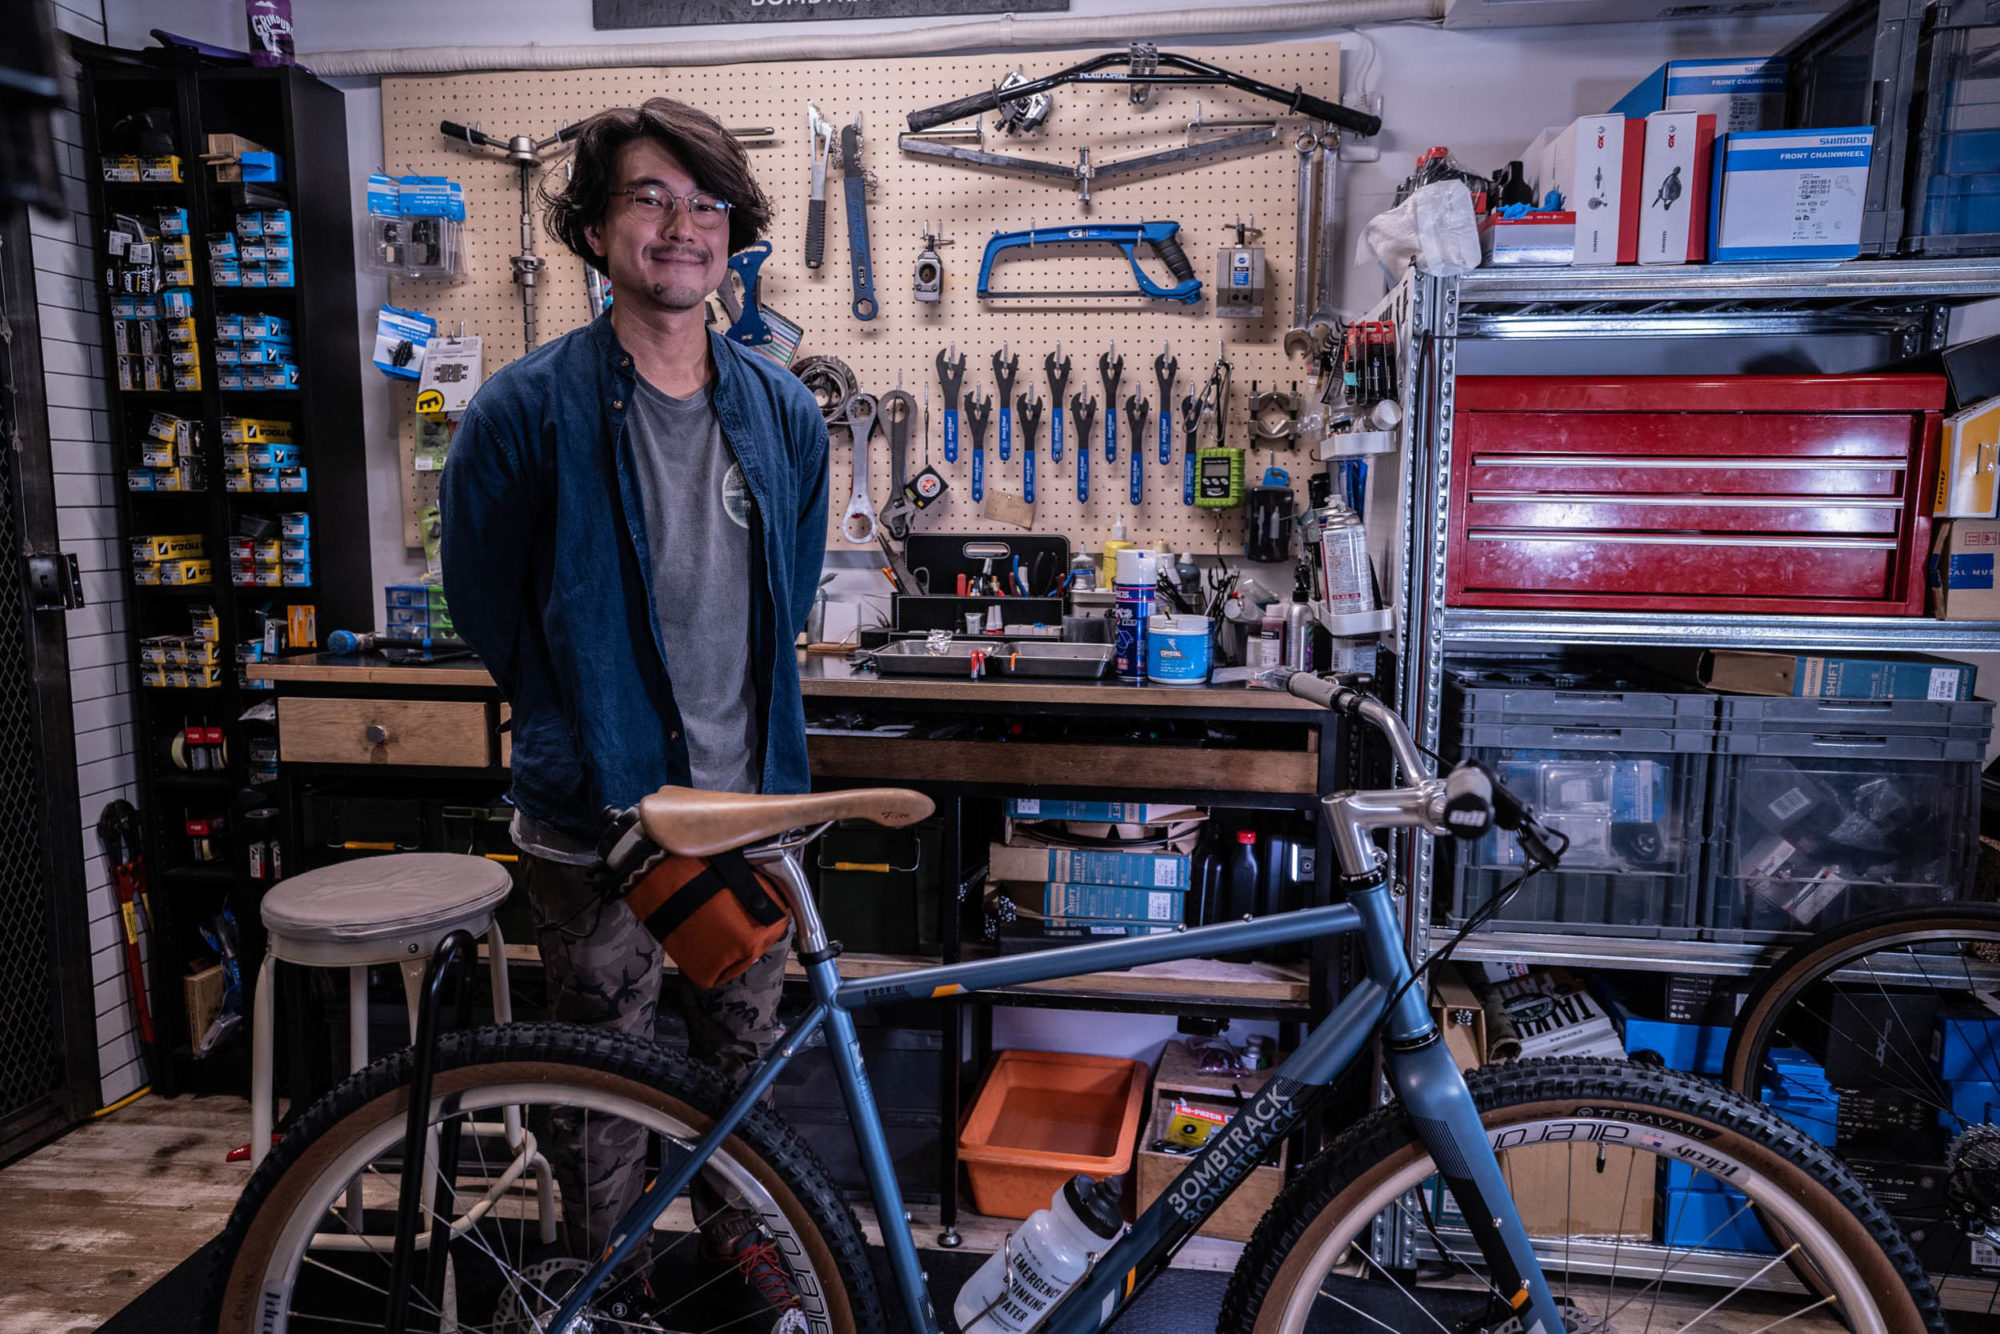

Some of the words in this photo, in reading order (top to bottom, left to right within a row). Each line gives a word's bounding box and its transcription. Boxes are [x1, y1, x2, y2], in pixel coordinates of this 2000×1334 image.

[1597, 135, 1605, 149] GX
[1667, 134, 1675, 149] GX
[1818, 136, 1868, 146] SHIMANO
[1779, 152, 1809, 160] FRONT
[1810, 150, 1866, 159] CHAINWHEEL
[1160, 649, 1182, 658] CRYSTAL
[1825, 661, 1839, 697] SHIFT
[1073, 854, 1082, 882] SHIFT
[1068, 887, 1076, 914] SHIFT
[1181, 1106, 1223, 1121] HI-PATCH
[1600, 1108, 1705, 1141] TERAVAIL
[1168, 1083, 1290, 1215] BOMBTRACK
[1671, 1142, 1740, 1179] Velocity
